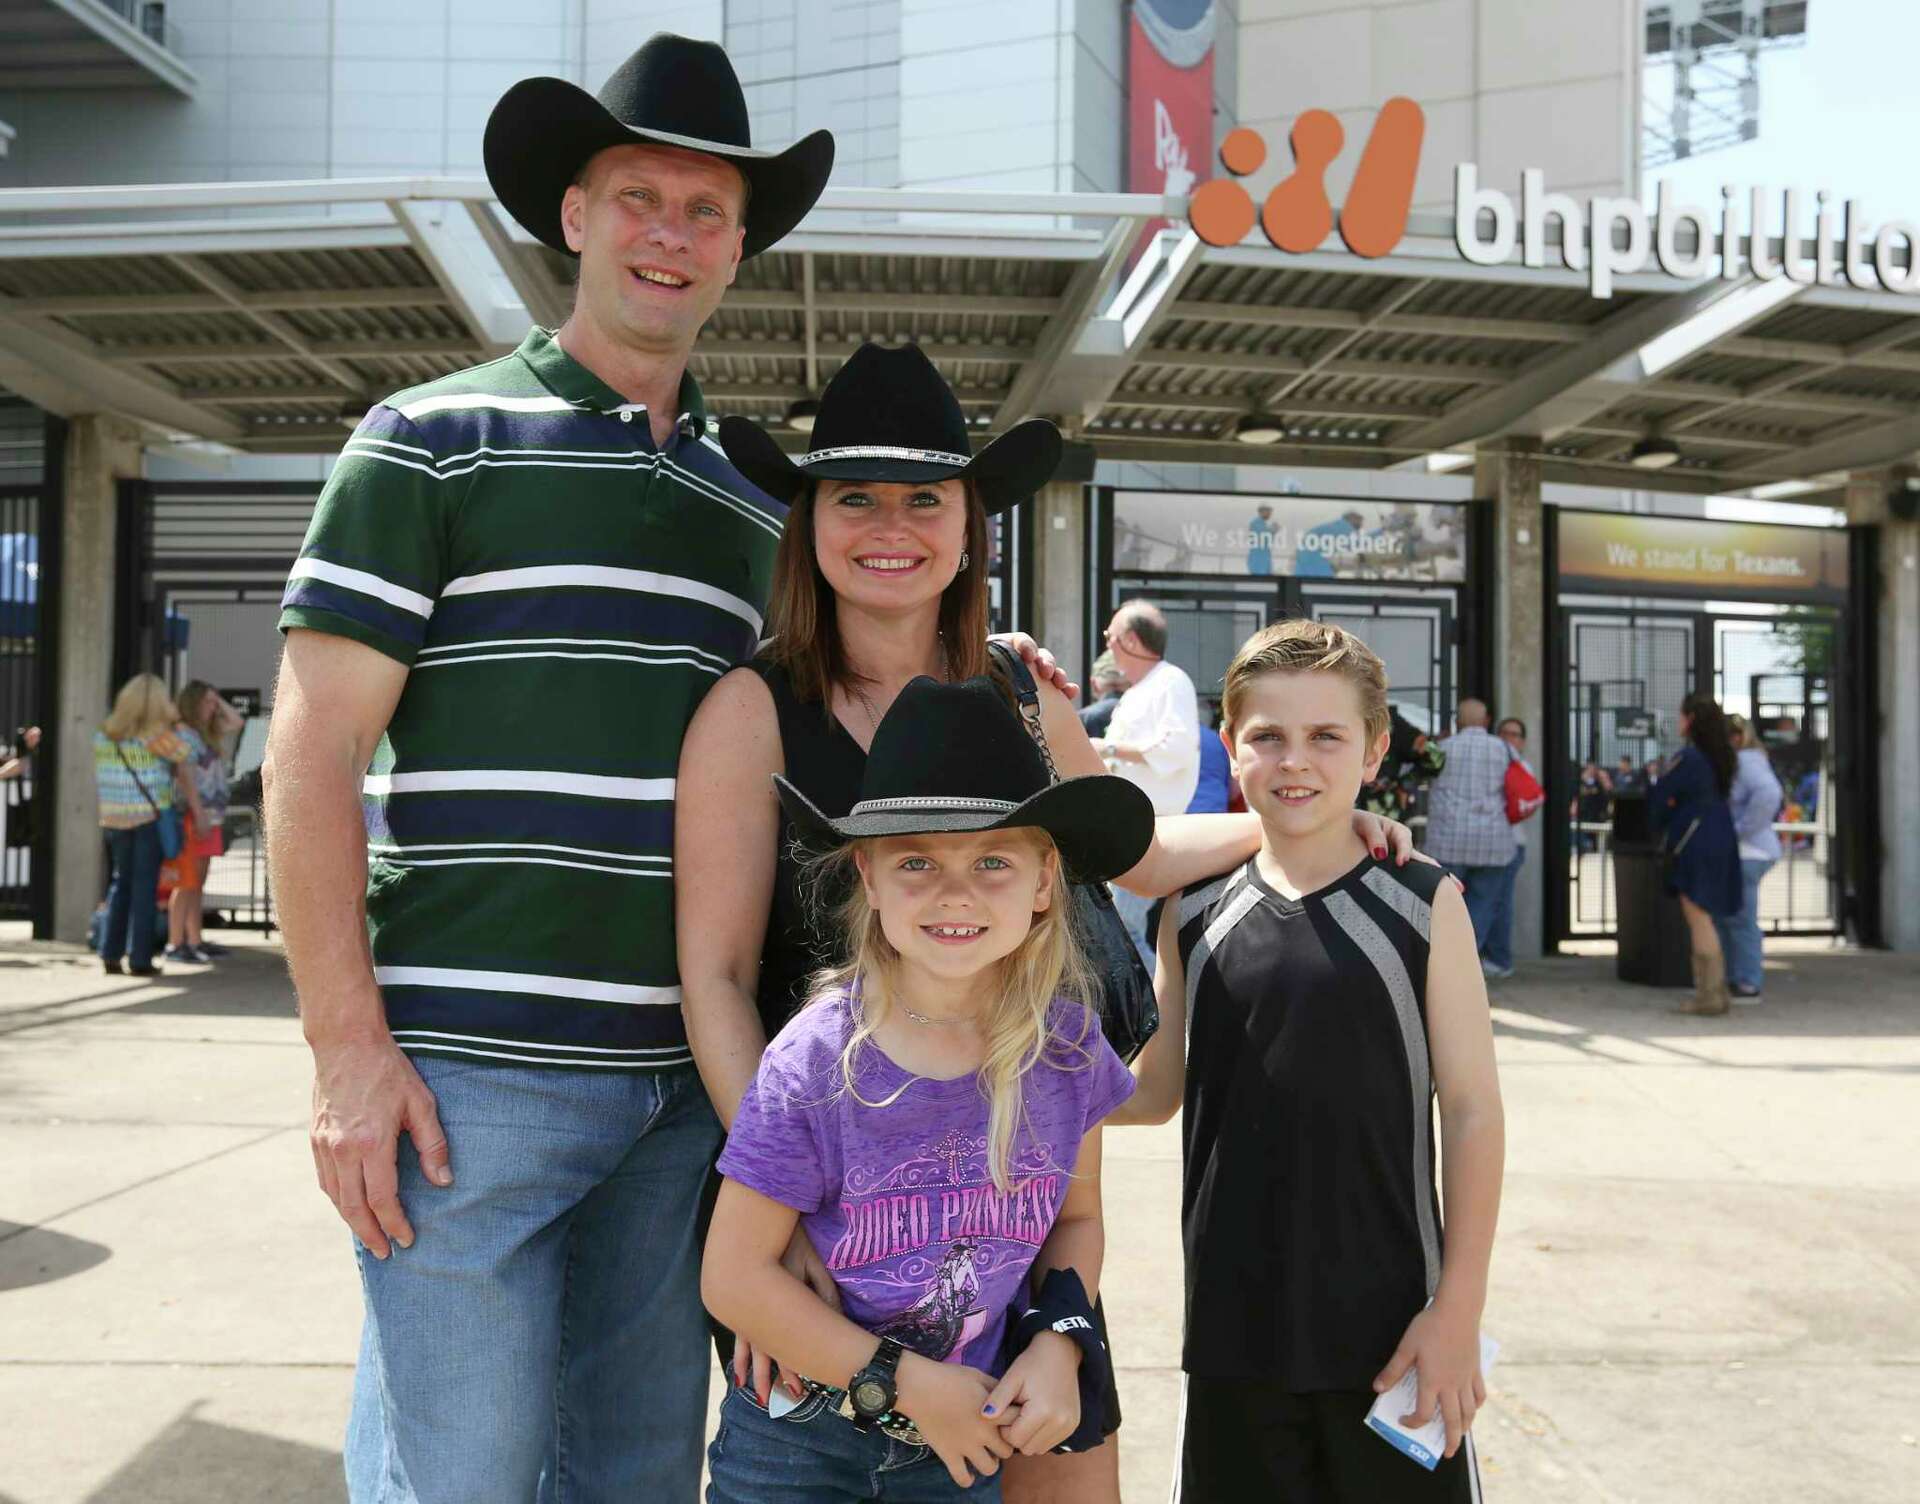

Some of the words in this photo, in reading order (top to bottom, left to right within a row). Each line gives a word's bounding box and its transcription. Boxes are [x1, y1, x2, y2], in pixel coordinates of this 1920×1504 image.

[1182, 522, 1218, 547] We
[1226, 528, 1287, 551] stand
[1297, 530, 1403, 554] together.
[1607, 543, 1637, 567] We
[1644, 549, 1696, 570] stand
[1701, 549, 1728, 570] for
[827, 1194, 930, 1268] RODEO
[940, 1175, 1058, 1246] PRINCESS
